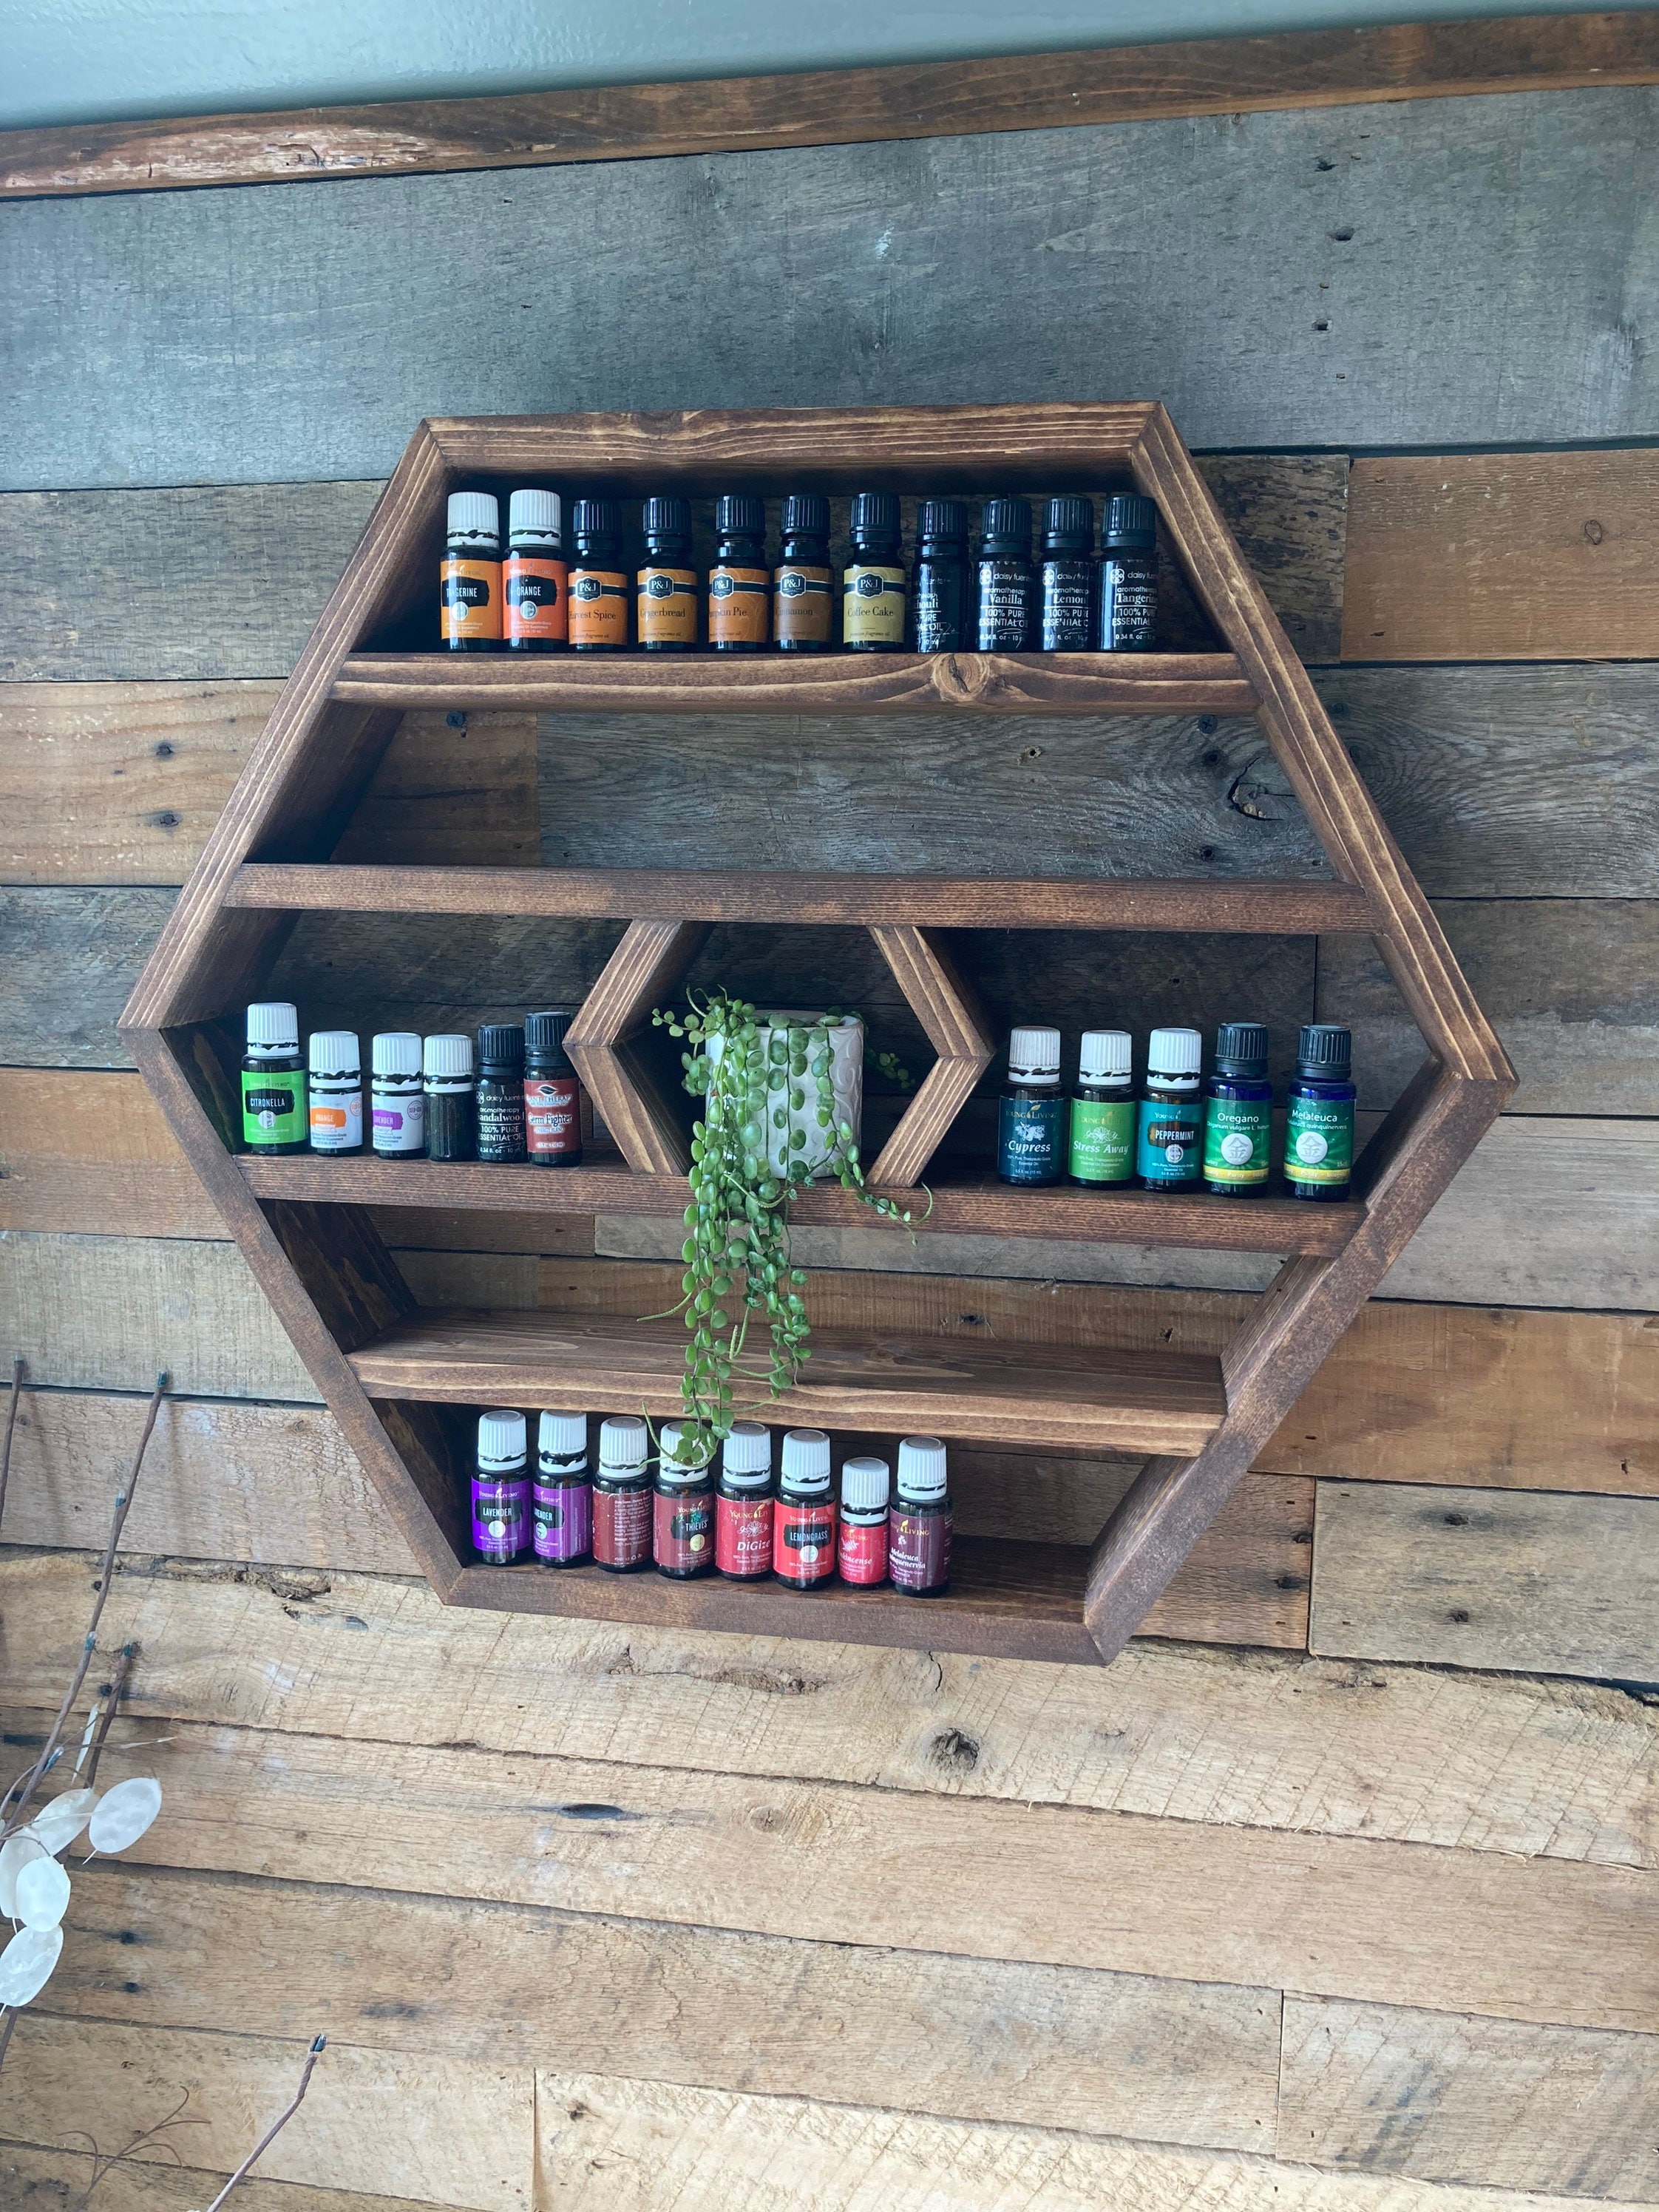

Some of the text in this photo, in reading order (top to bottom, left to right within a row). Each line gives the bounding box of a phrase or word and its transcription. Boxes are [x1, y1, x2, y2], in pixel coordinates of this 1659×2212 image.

[994, 572, 1013, 581] daisy
[1127, 571, 1146, 580] daisy
[580, 583, 596, 592] P&J
[651, 580, 668, 590] P&J
[714, 580, 730, 590] P&J
[784, 578, 801, 588] P&J
[860, 579, 878, 588] P&J
[446, 587, 478, 598] TGERINE
[517, 586, 541, 596] ORANGE
[983, 587, 1025, 596] aromatherap
[990, 594, 1022, 605] Vanilla
[1053, 594, 1086, 604] Lemon
[1116, 593, 1158, 605] Tangerin
[593, 609, 617, 621] Spice
[733, 606, 747, 617] Pie
[776, 606, 813, 616] Cinnamon
[847, 606, 894, 617] Coffee Cake
[985, 608, 1025, 619] 100% PURE
[1049, 608, 1070, 617] 100%
[1119, 608, 1141, 617] 100%
[979, 618, 1017, 627] ESSENTIAL
[250, 1098, 285, 1107] CITRONELLA
[477, 1112, 525, 1122] andalwood
[1005, 1110, 1056, 1119] YOUNG LIVING
[1218, 1112, 1259, 1124] Oregano
[1292, 1110, 1337, 1122] Melaleuca
[546, 1113, 572, 1127] Fighter
[1155, 1130, 1194, 1140] PEPPERMINT
[1008, 1140, 1051, 1155] Cypress
[1073, 1140, 1129, 1155] Stress Away
[478, 1490, 495, 1499] YOUNG
[483, 1507, 512, 1517] LAVENDER
[730, 1510, 769, 1519] YOUNG LIV
[685, 1519, 708, 1532] THIEVES
[790, 1530, 828, 1541] LEMONGRASS
[905, 1527, 930, 1536] LIVING
[737, 1539, 770, 1551] DiGize
[891, 1547, 920, 1561] Melaleuca
